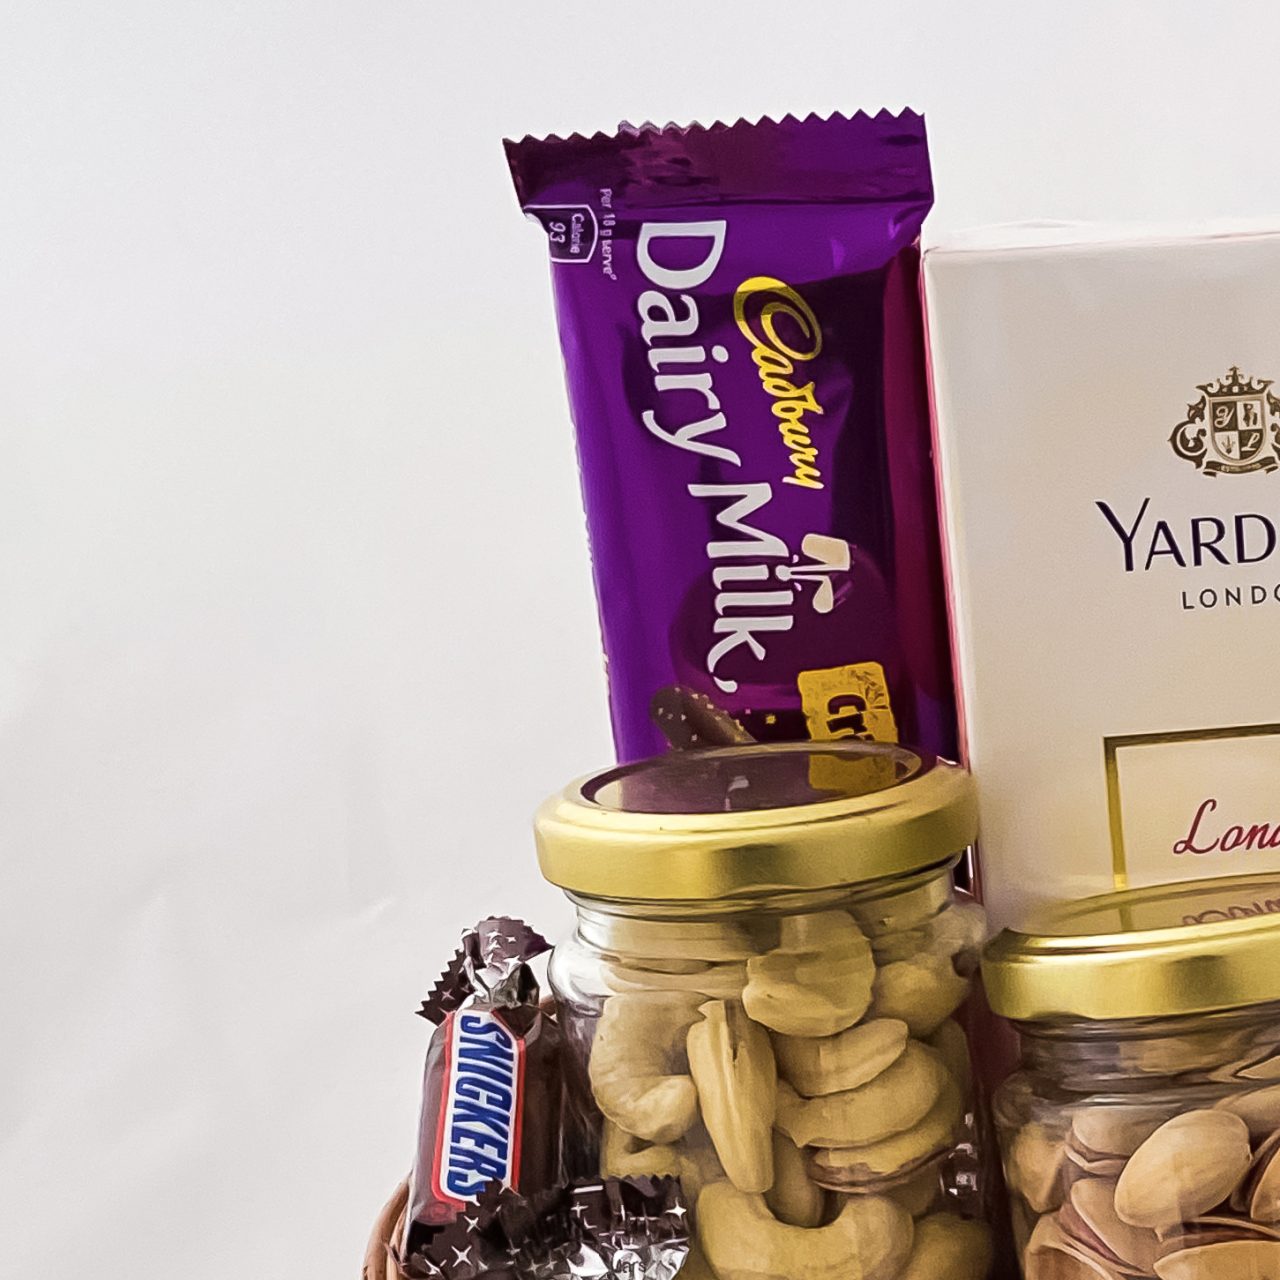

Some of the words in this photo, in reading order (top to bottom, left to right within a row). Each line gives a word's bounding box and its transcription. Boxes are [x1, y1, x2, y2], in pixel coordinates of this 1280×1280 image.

[549, 221, 566, 243] 93
[636, 219, 741, 468] Dairy
[733, 276, 823, 490] Cadbury
[687, 483, 794, 693] Milk
[446, 1014, 515, 1197] SNICKERS
